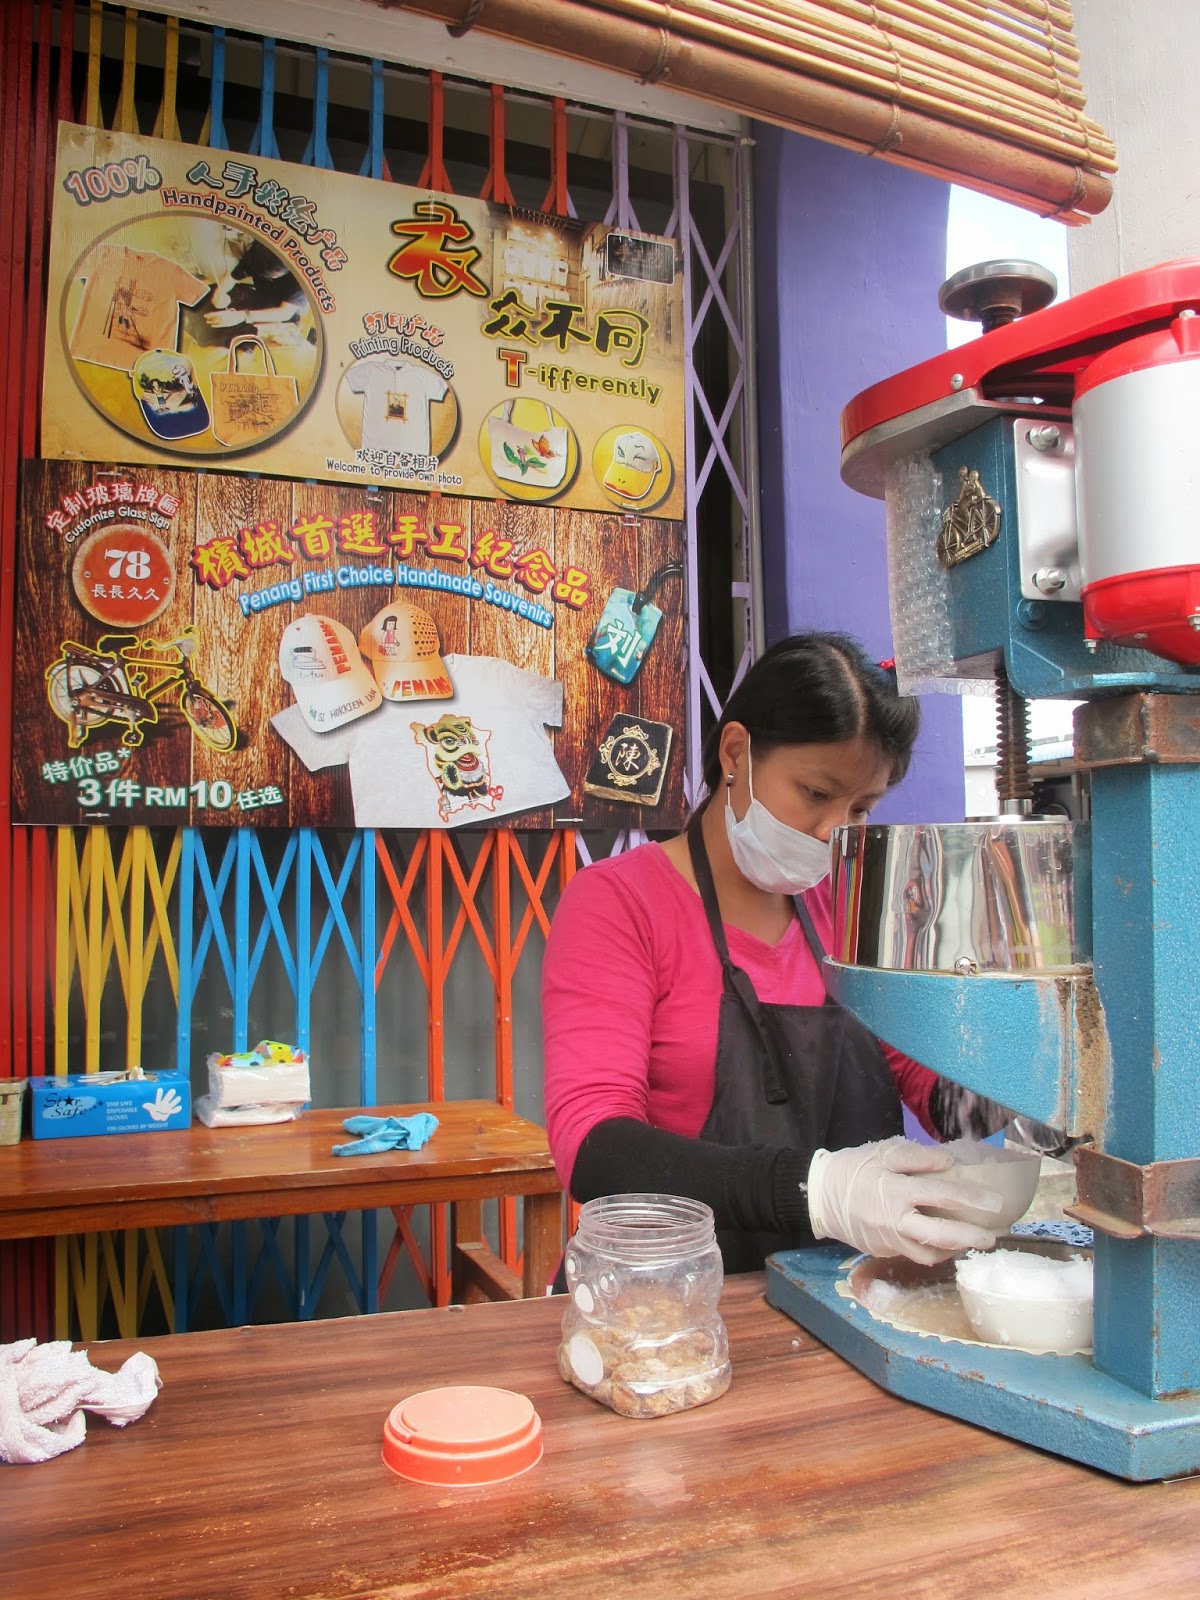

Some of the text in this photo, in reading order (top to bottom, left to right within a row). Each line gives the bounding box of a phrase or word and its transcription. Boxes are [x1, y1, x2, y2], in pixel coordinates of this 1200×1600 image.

[65, 156, 160, 204] 100%
[187, 162, 348, 270] 人手彩绘产品
[162, 189, 335, 313] Handpainted Products
[387, 201, 490, 298] 衣
[363, 312, 444, 346] 打印产品
[484, 290, 650, 366] 众不同
[350, 335, 453, 379] Printing Products
[498, 348, 661, 405] T-ifferently
[327, 459, 462, 485] Welcome to provide own photo
[356, 449, 438, 471] 欢迎自备相片
[47, 483, 180, 533] 定制玻璃牌匾
[65, 507, 170, 543] Customize Glass Sign
[104, 549, 151, 580] 78
[196, 512, 589, 606] 檳城首選手工紀念品
[92, 584, 160, 601] 長長久久
[239, 565, 552, 627] Penang First Choice Handmade Souvenirs
[595, 619, 641, 668] 刘
[330, 699, 363, 719] HOKKIEN
[615, 742, 641, 771] 陳
[237, 785, 283, 811] 任选
